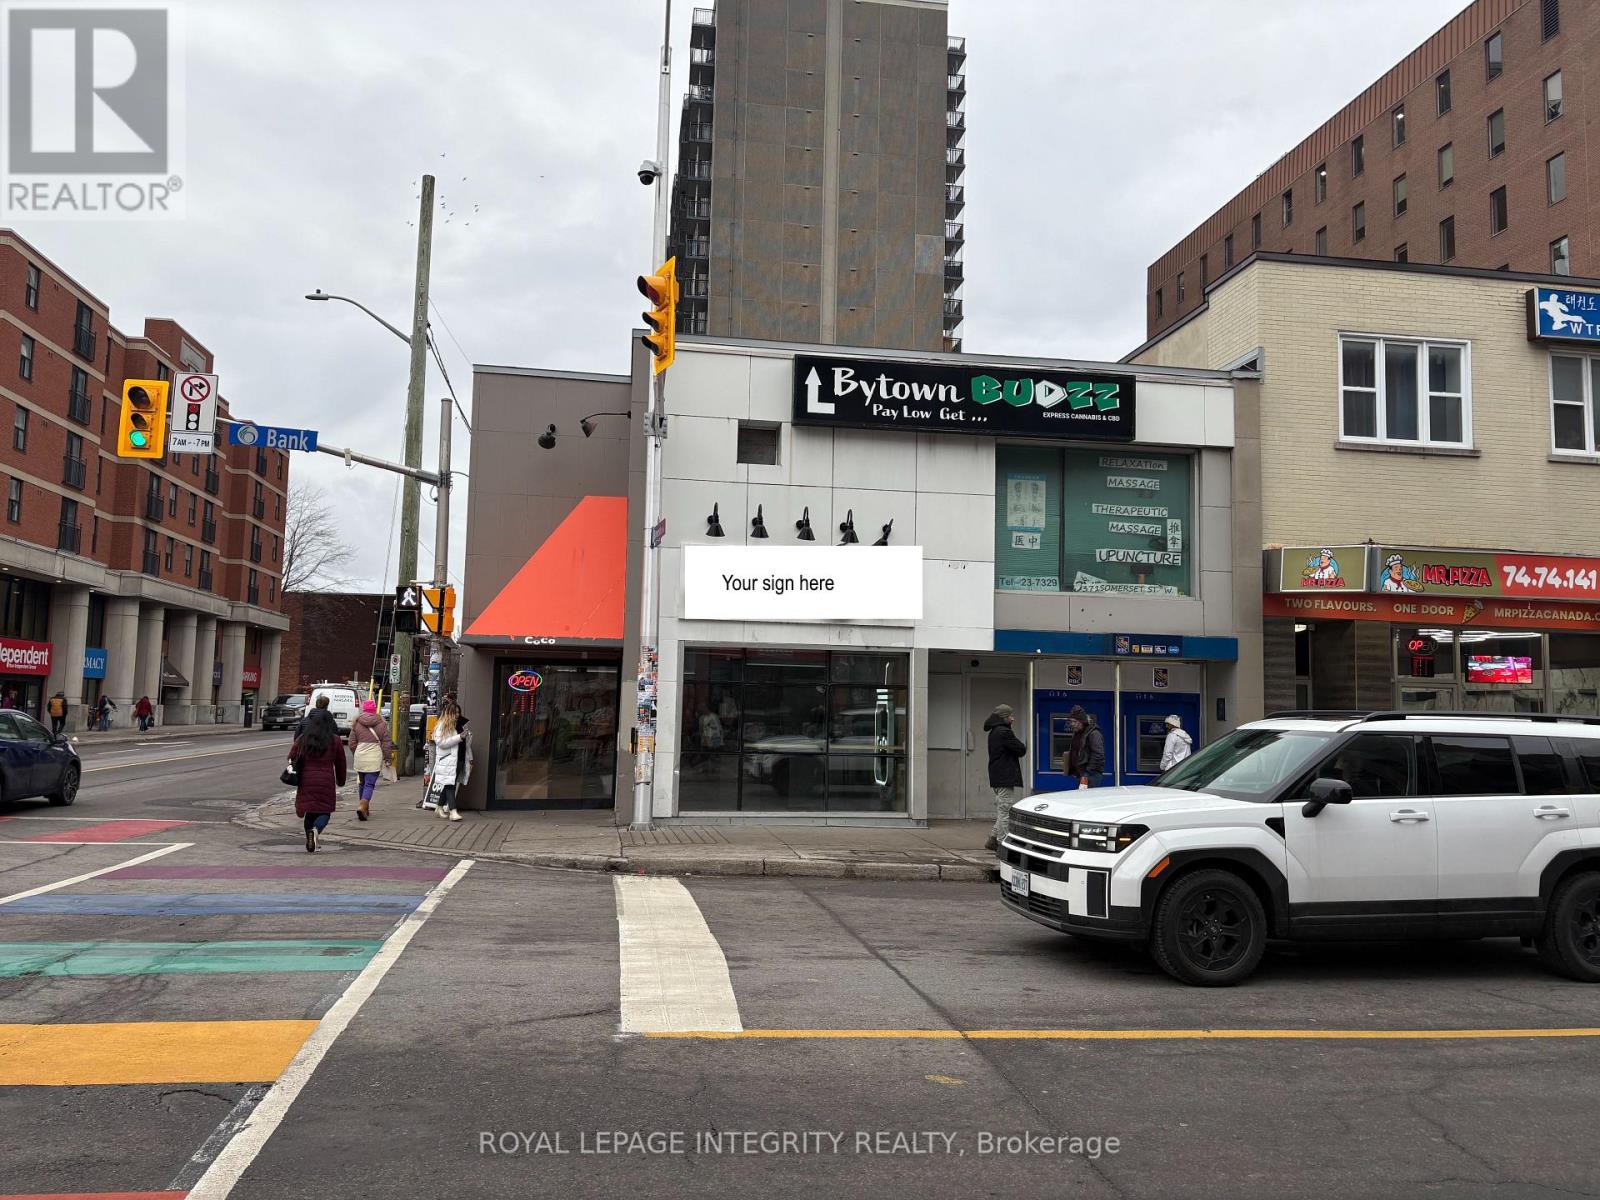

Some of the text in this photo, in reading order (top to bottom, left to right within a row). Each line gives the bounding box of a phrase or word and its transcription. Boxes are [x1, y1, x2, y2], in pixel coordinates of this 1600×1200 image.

[832, 367, 1120, 412] Bytown BUDZZ
[873, 403, 899, 420] Pay
[903, 405, 932, 419] Low
[940, 407, 966, 421] Get
[1043, 411, 1070, 419] EXPRESS
[1071, 413, 1101, 421] CANNABIS
[266, 428, 310, 451] Bank
[1108, 478, 1160, 489] MASSAGE
[1094, 504, 1168, 517] THERAPEUTIC
[1110, 523, 1161, 535] MASSAGE
[1099, 549, 1180, 565] UPUNCTURE
[1503, 565, 1597, 590] 74.74.141
[1285, 598, 1312, 608] TWO
[1314, 600, 1377, 612] FLAVOURS.
[1393, 603, 1417, 614] ONE
[1421, 604, 1454, 615] DOOR
[511, 675, 539, 688] OPEN
